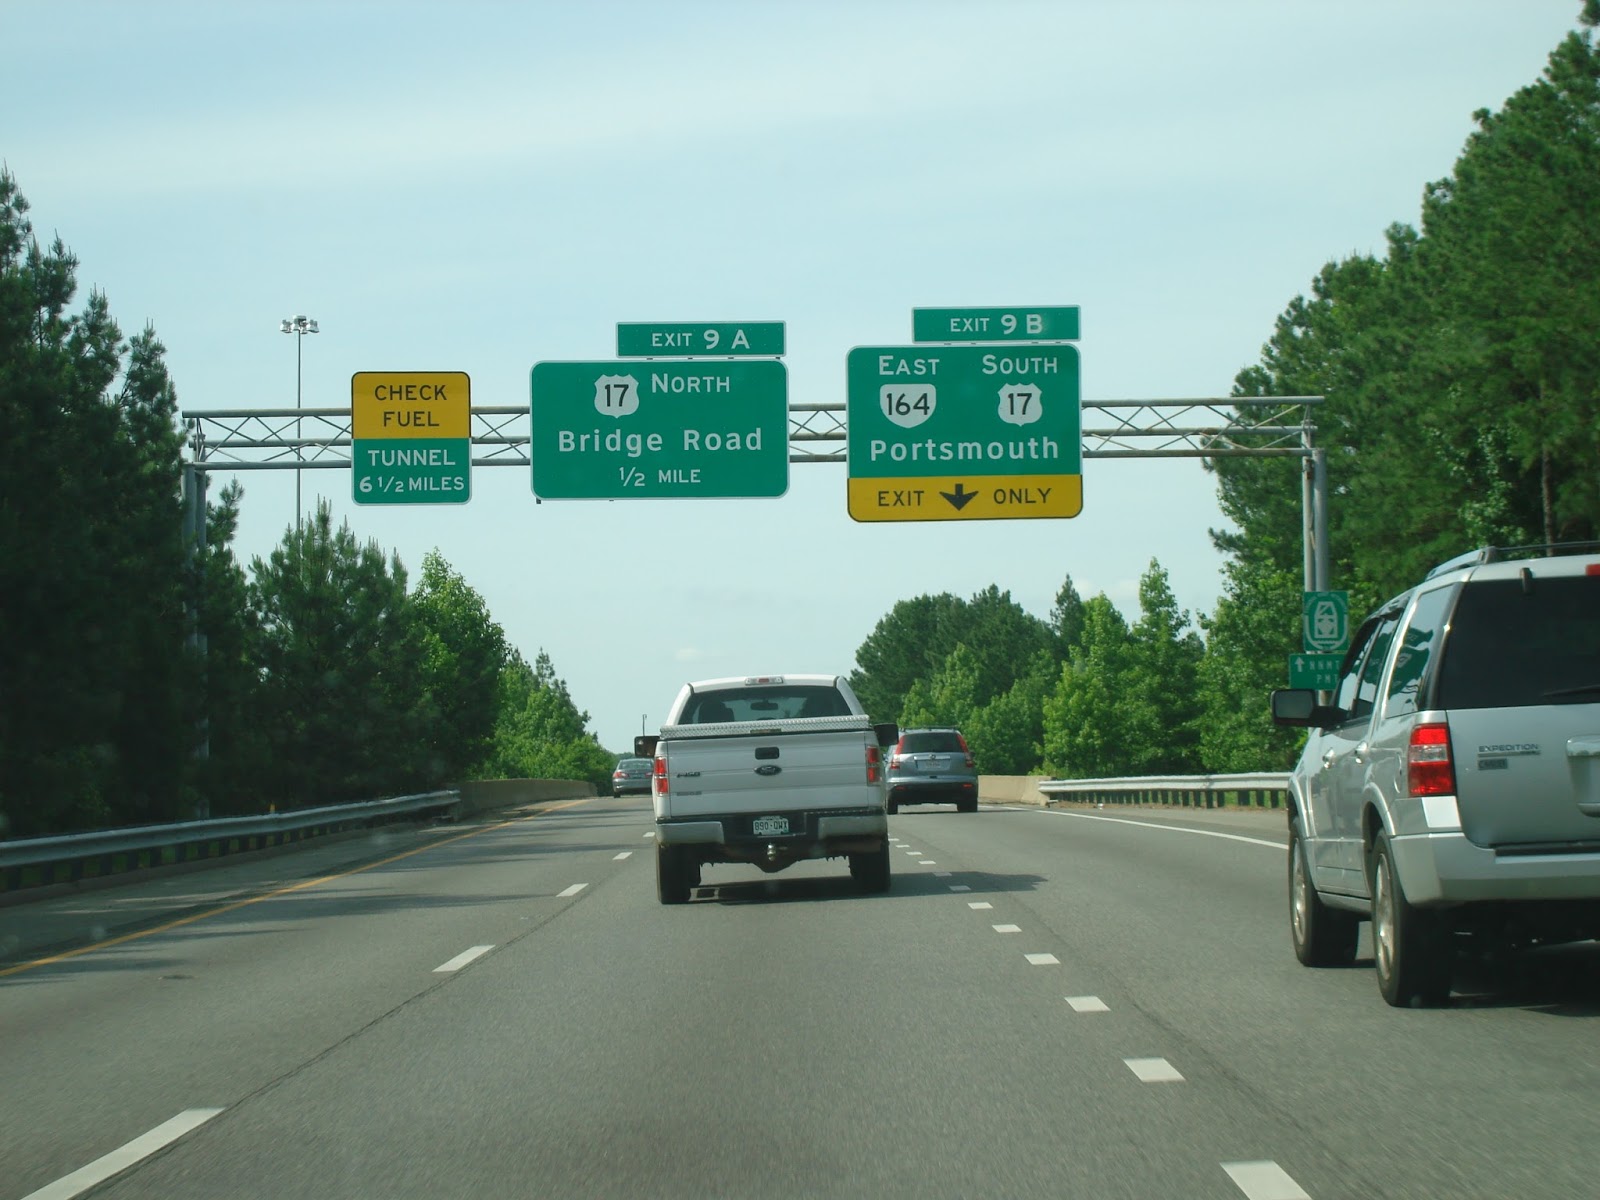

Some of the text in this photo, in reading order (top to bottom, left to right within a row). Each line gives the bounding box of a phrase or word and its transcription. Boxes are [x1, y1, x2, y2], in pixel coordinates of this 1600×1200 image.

[950, 313, 1043, 335] EXIT 9 B
[651, 329, 750, 350] EXIT 9 A
[878, 355, 940, 376] EAST
[981, 354, 1058, 375] SOUTH
[374, 384, 447, 401] CHECK
[651, 373, 730, 394] NORTH
[604, 383, 630, 407] 17
[886, 392, 930, 416] 164
[1007, 392, 1033, 416] 17
[383, 411, 440, 427] FUEL
[558, 427, 762, 458] Bridge Road
[870, 436, 1059, 462] Portsmouth
[367, 449, 456, 467] TUNNEL
[359, 476, 373, 493] 6
[408, 476, 465, 491] MILES
[658, 469, 701, 484] MILE
[878, 487, 1052, 507] EXIT ONLY
[1479, 743, 1538, 752] EXPEDITION
